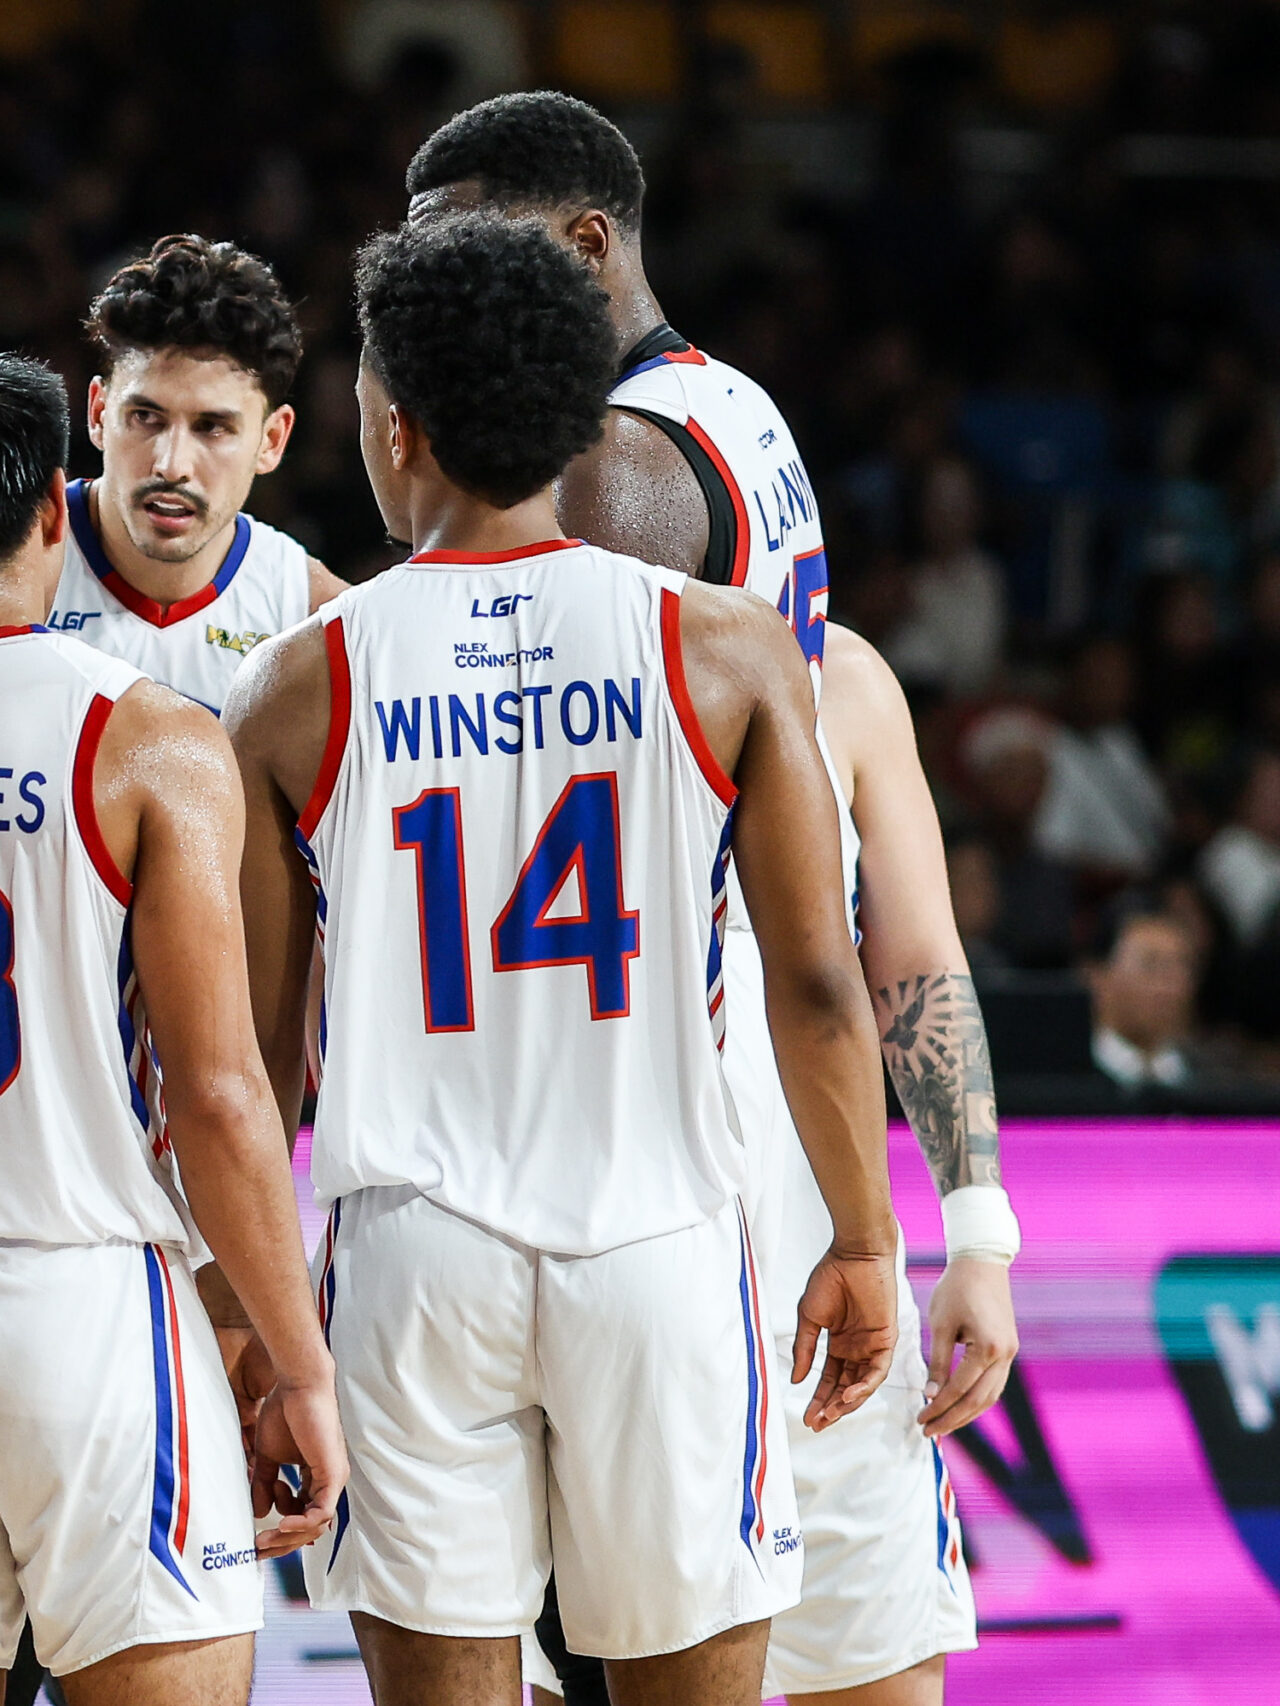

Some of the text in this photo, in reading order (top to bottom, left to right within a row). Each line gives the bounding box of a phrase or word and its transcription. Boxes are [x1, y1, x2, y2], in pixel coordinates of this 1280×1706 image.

[454, 643, 488, 653] NLEX
[455, 647, 554, 668] CONNECTOR
[375, 678, 642, 762] WINSTON
[392, 771, 640, 1034] 14
[203, 1542, 226, 1555] NLEX
[202, 1549, 257, 1571] CONNECT
